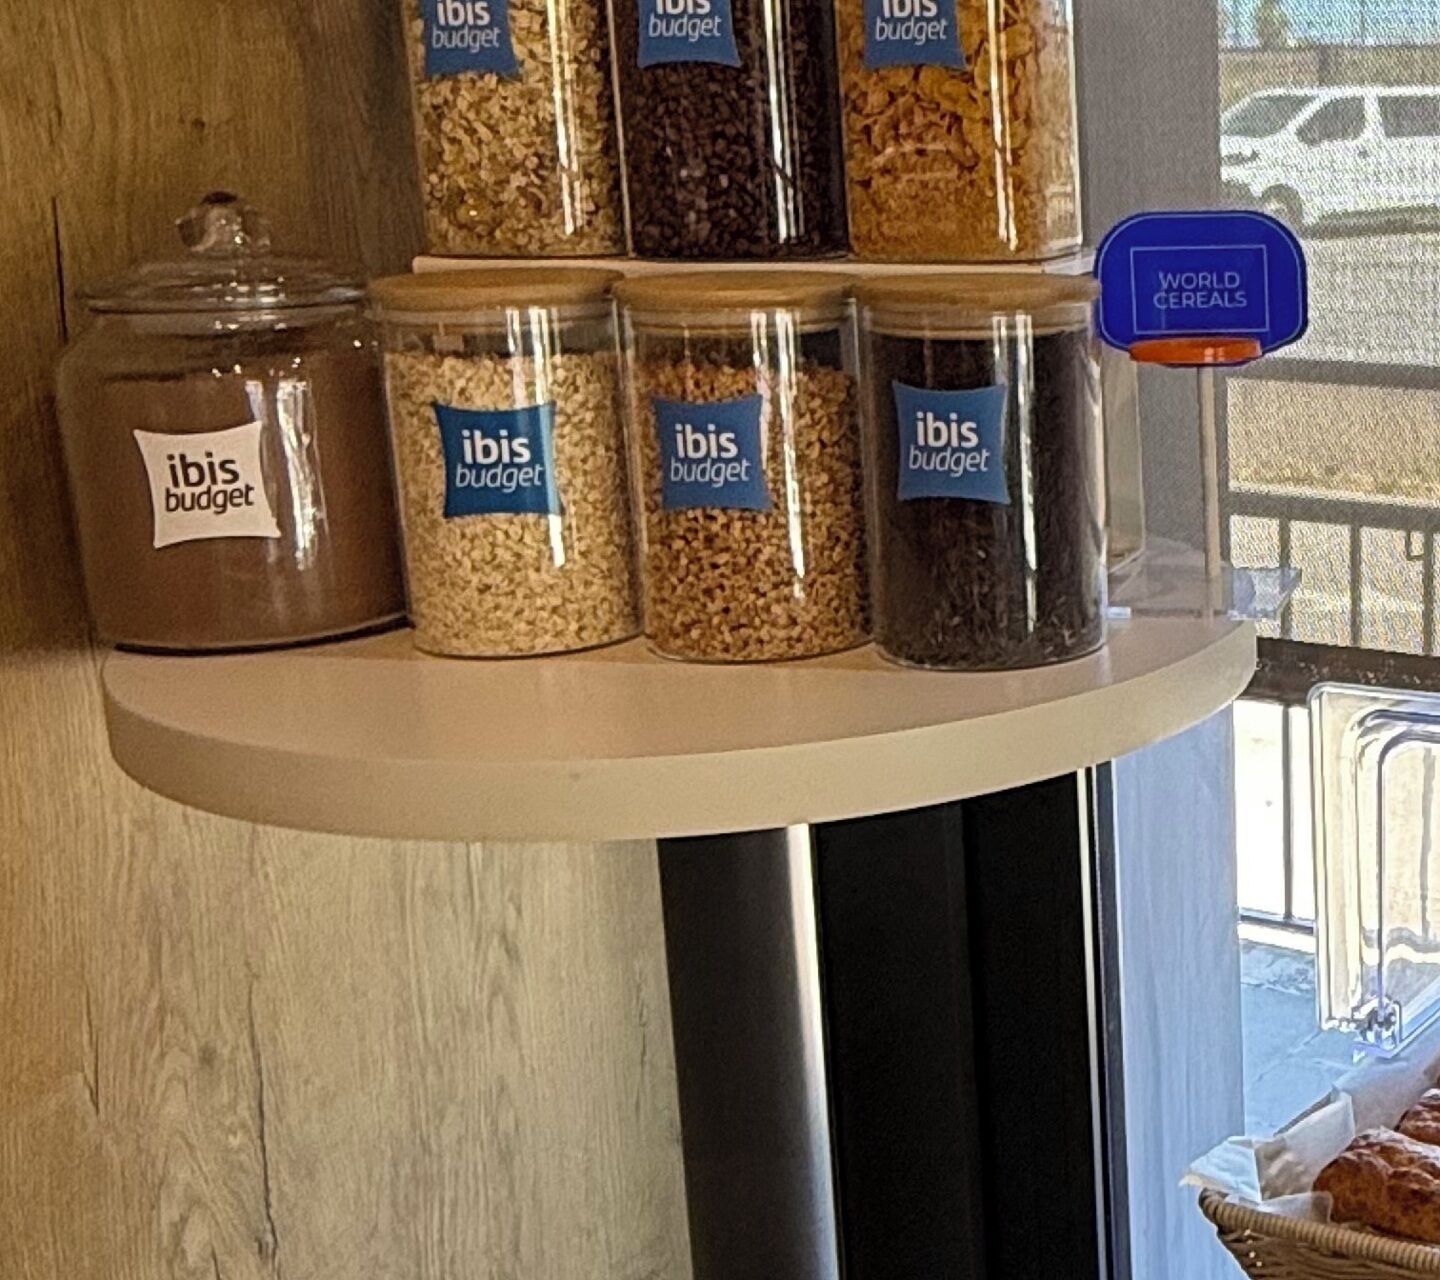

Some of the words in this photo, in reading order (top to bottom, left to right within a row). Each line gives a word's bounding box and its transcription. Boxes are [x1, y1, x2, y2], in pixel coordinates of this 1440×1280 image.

[432, 25, 500, 52] budget
[648, 13, 722, 41] budget
[875, 17, 947, 44] budget
[1159, 271, 1240, 290] WORLD
[1153, 291, 1247, 309] CEREALS
[676, 423, 738, 458] ibis
[916, 412, 979, 447] ibis
[462, 429, 531, 463] ibis
[168, 452, 239, 487] ibis
[670, 457, 750, 487] budget
[908, 446, 990, 477] budget
[456, 462, 542, 492] budget
[165, 484, 254, 514] budget
